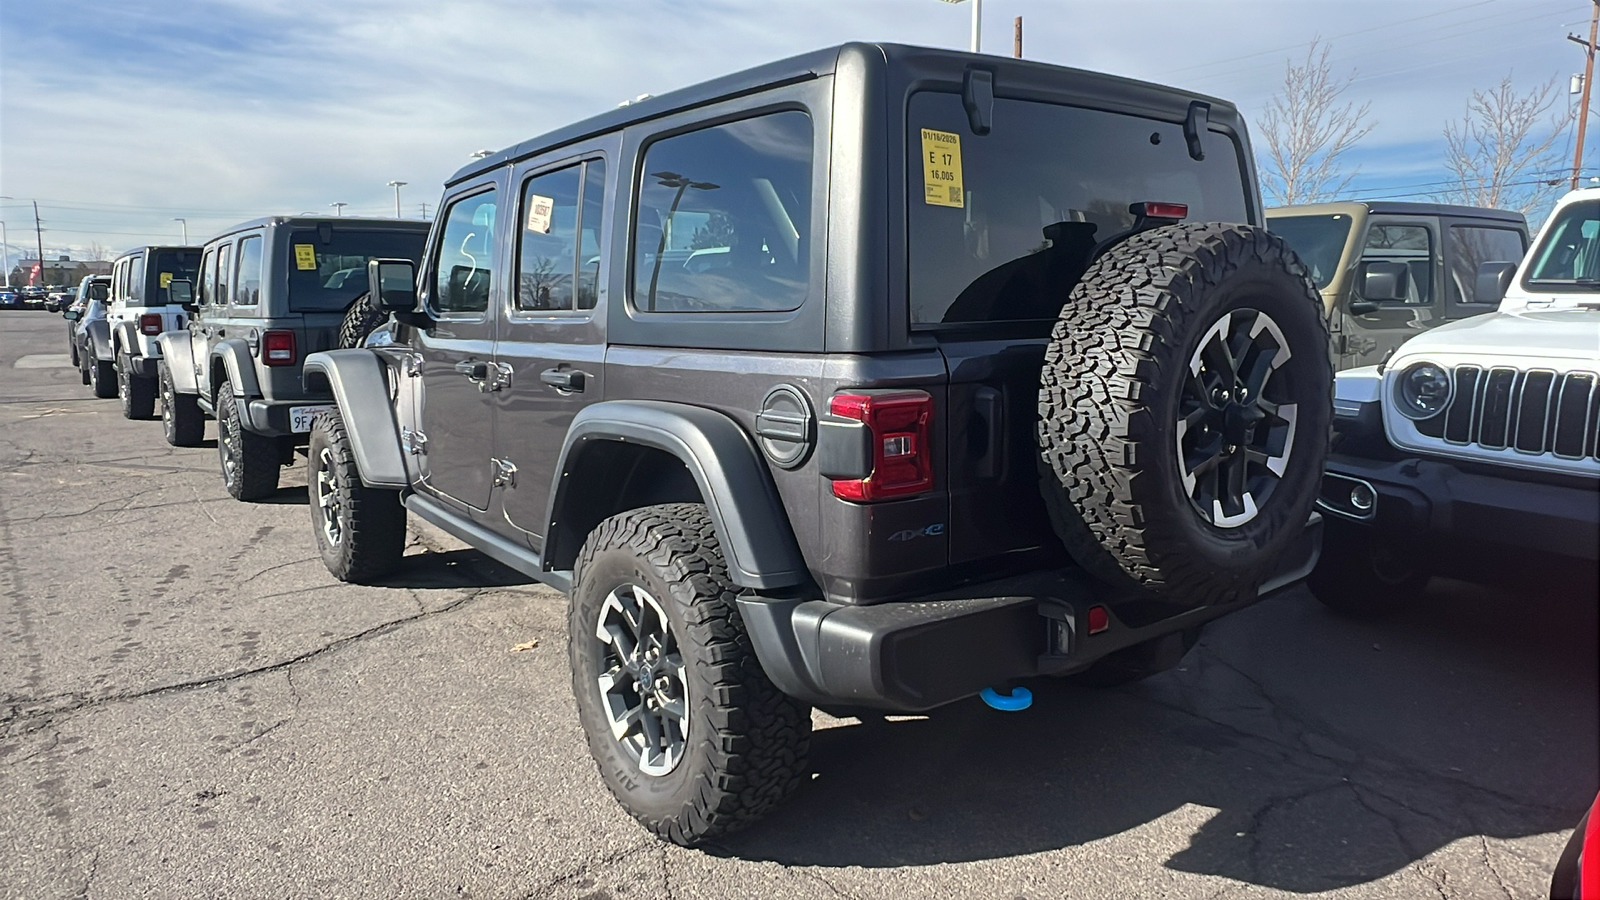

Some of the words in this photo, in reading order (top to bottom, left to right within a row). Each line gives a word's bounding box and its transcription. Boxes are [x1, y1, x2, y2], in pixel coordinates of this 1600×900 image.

[923, 131, 957, 144] 01/16/2026
[930, 152, 935, 164] E
[942, 153, 952, 166] 17
[294, 415, 308, 429] 9F
